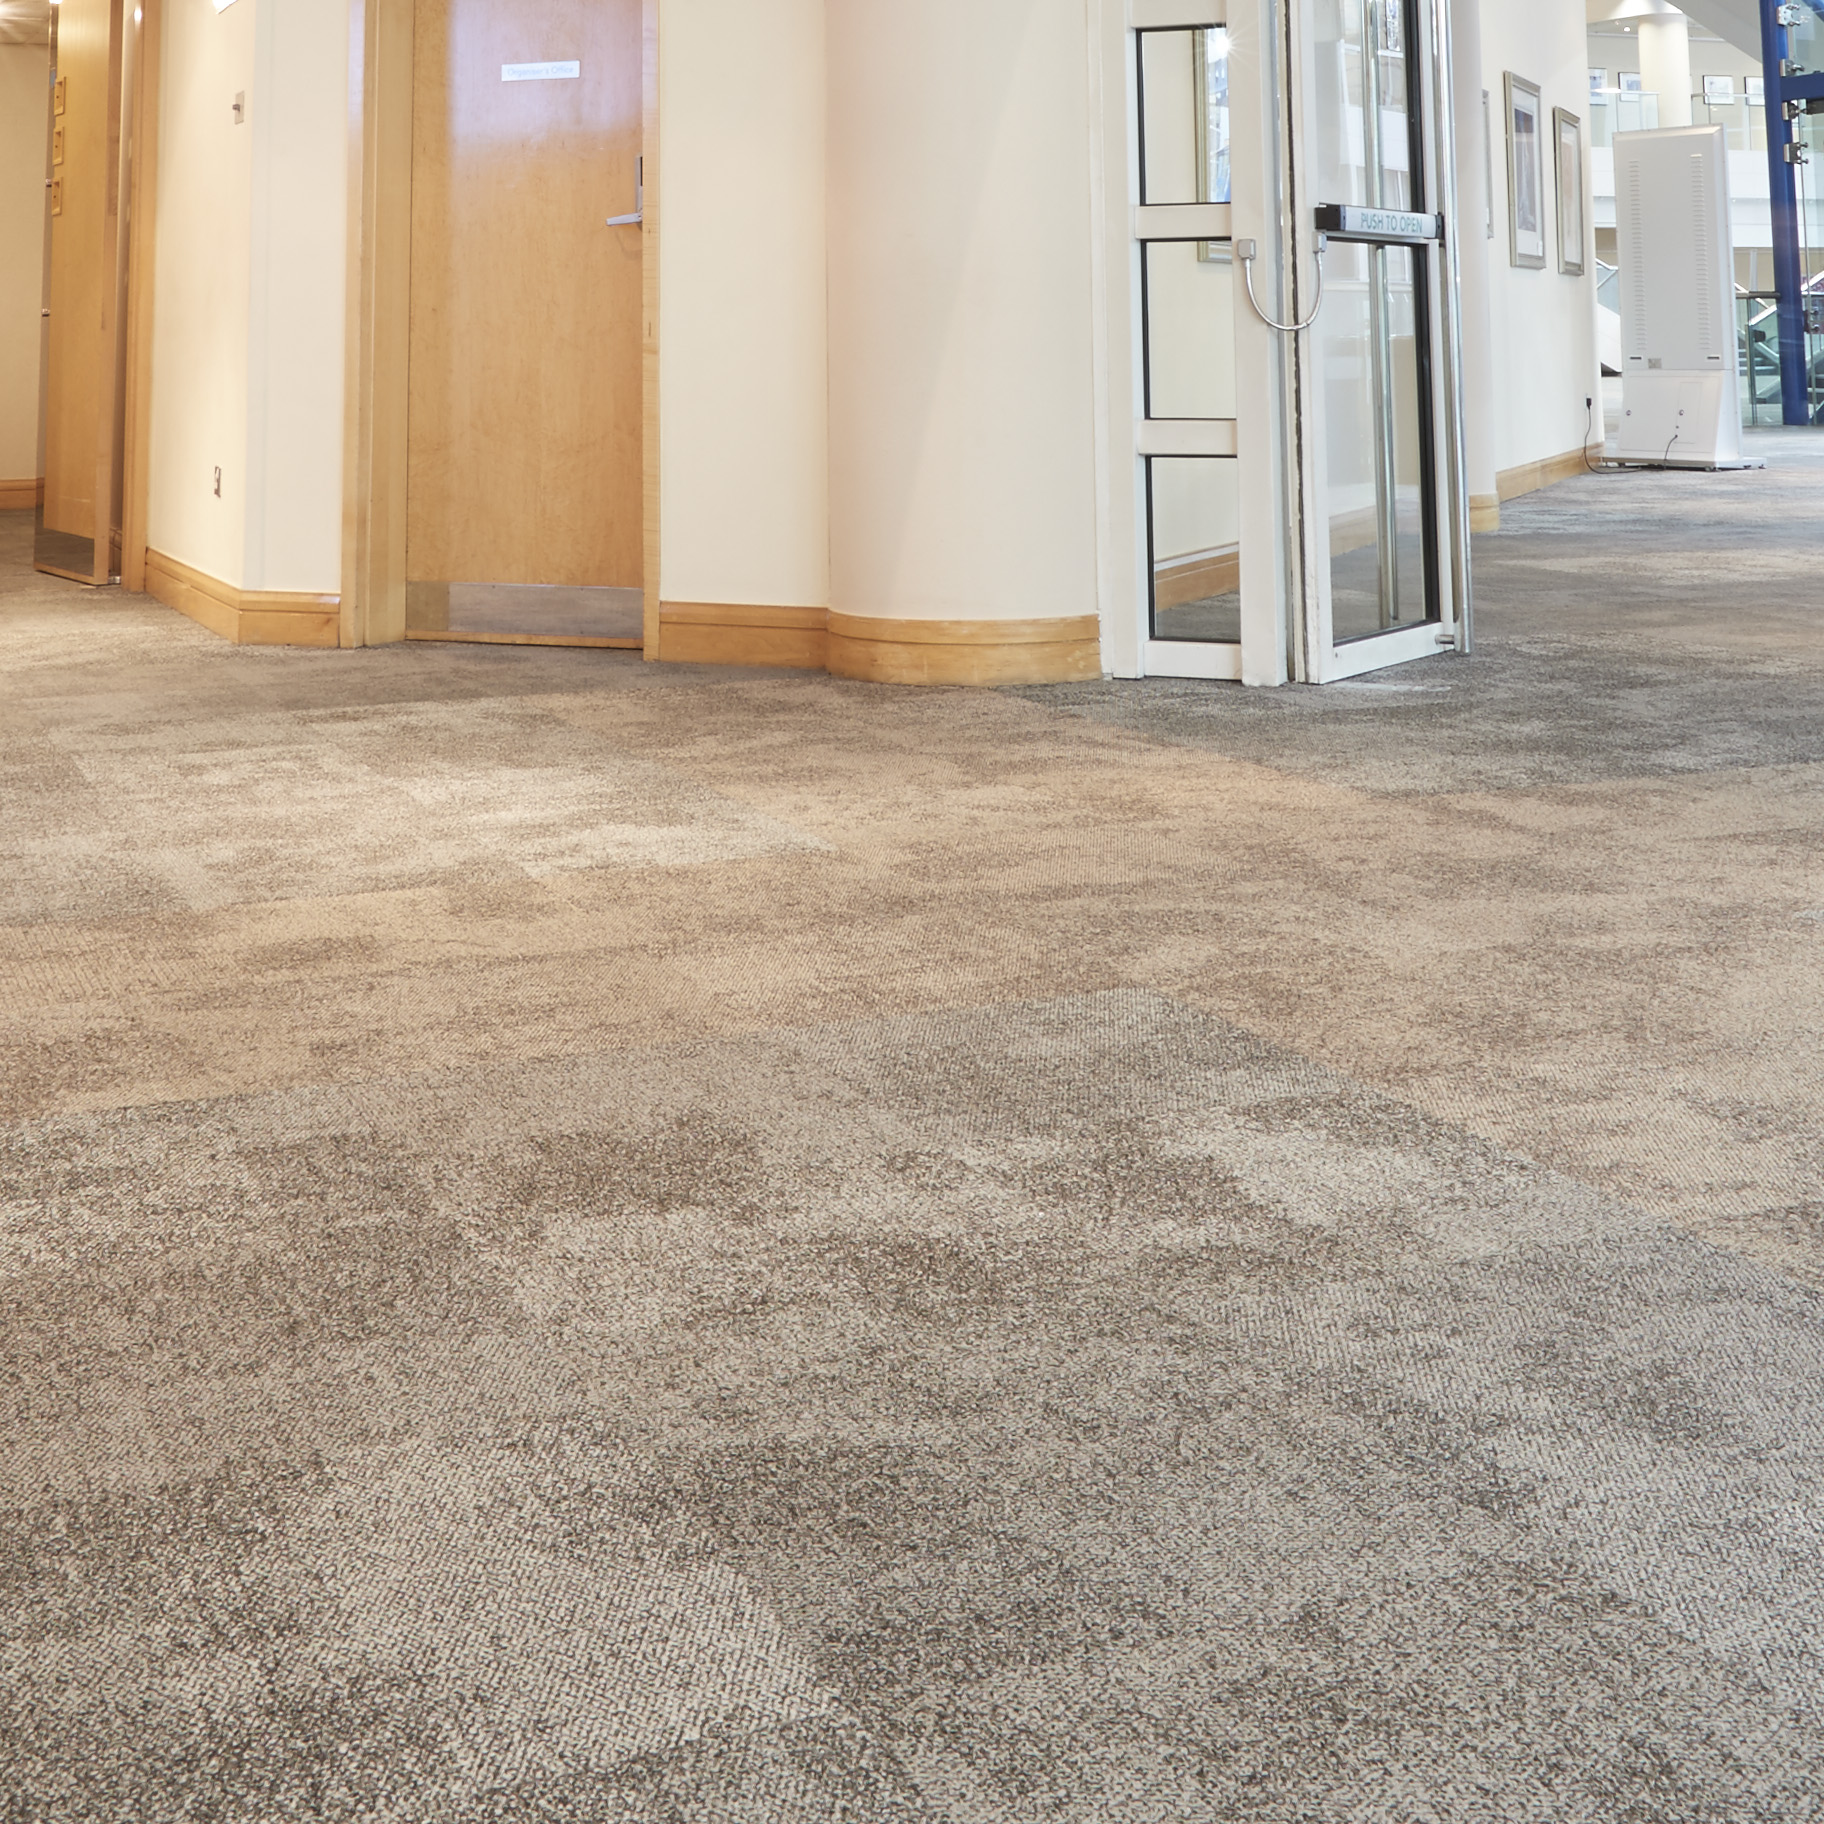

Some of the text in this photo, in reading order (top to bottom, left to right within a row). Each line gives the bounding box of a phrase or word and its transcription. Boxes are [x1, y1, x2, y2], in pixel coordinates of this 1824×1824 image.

[1361, 212, 1423, 233] PUSH TO OPEN
